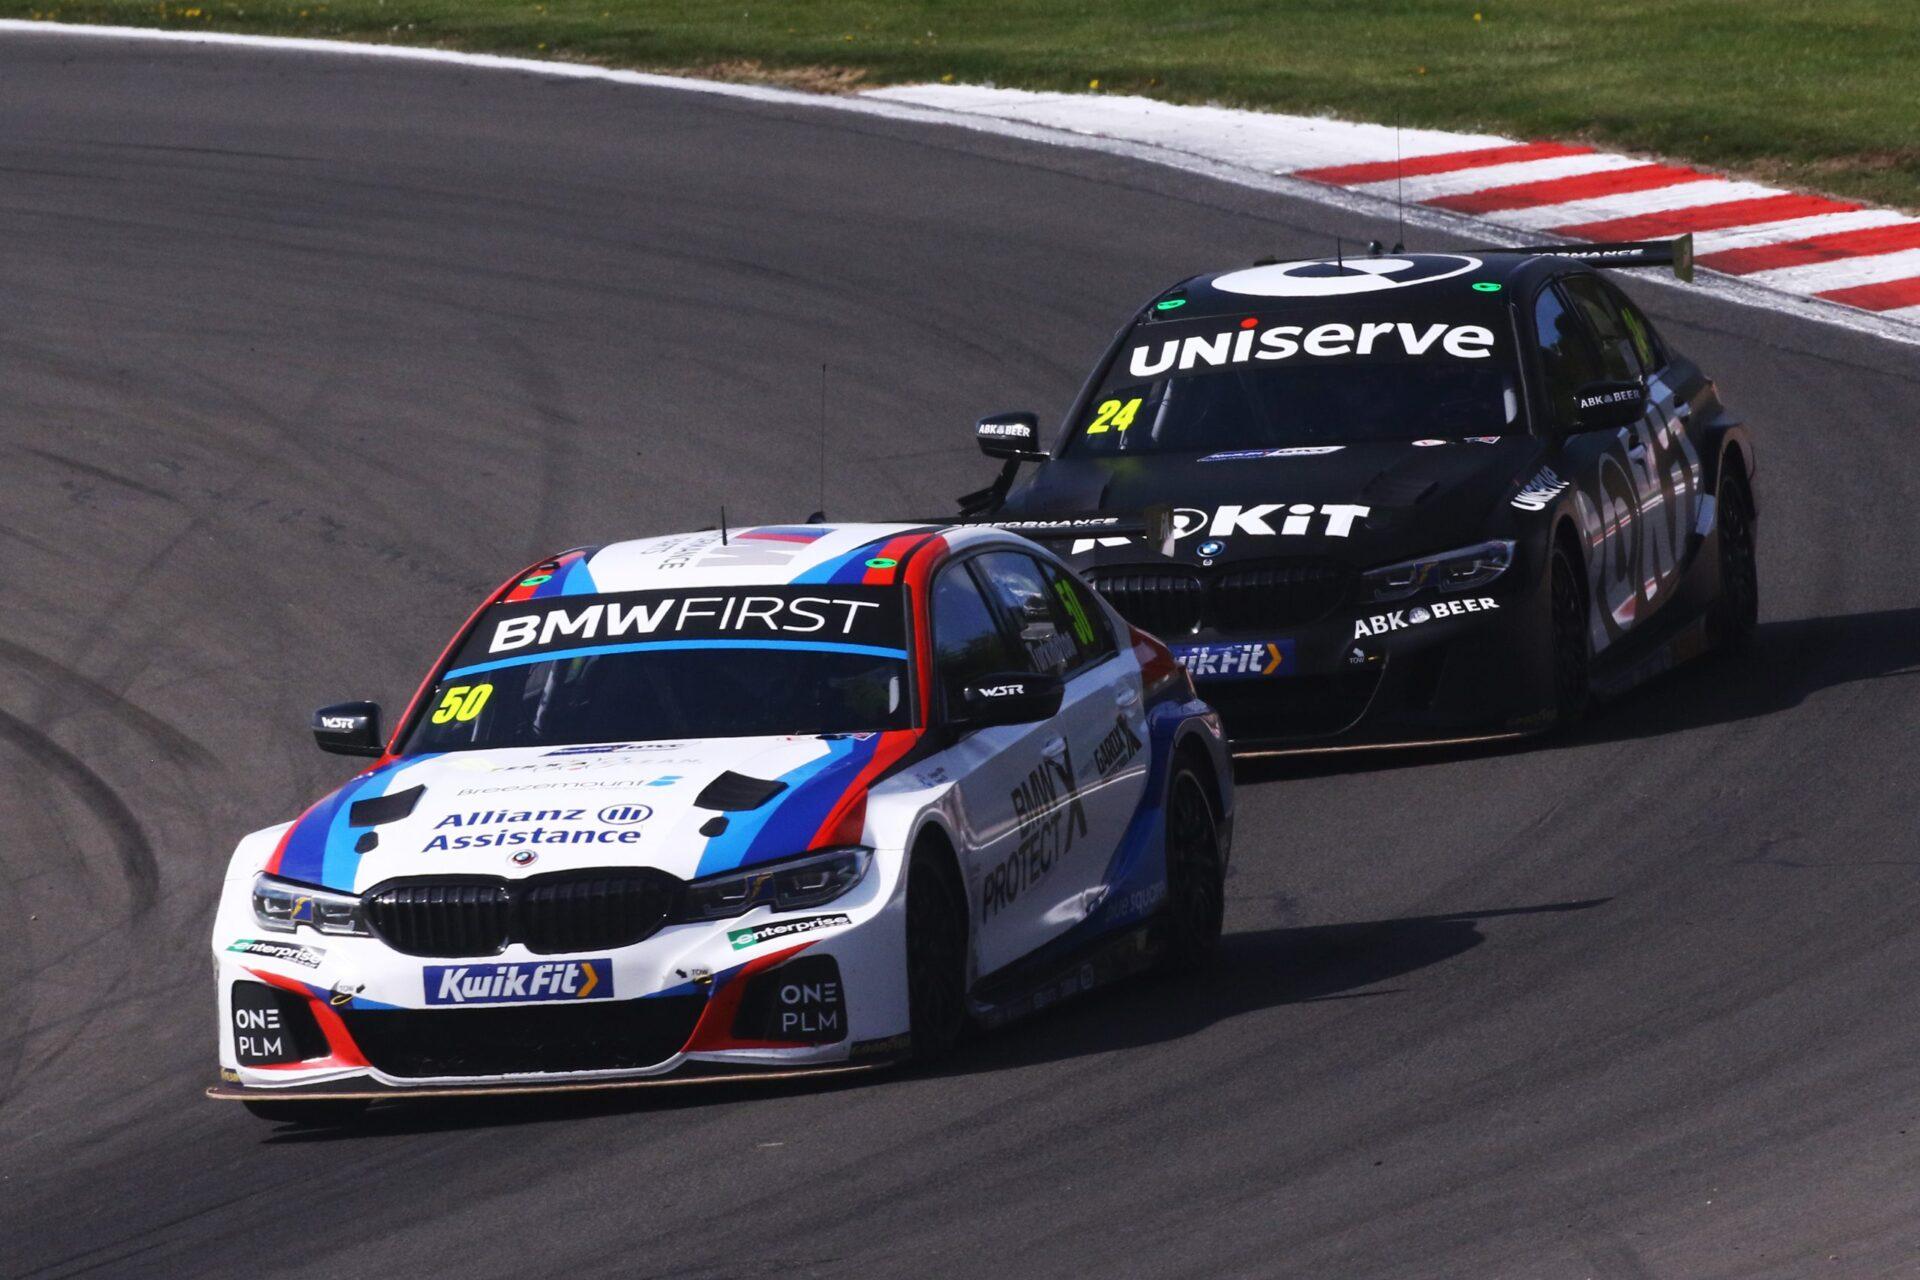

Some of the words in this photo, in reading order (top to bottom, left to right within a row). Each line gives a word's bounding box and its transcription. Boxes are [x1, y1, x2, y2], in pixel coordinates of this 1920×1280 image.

[1580, 395, 1604, 409] ABK
[1613, 388, 1641, 402] BEER
[1086, 398, 1143, 435] 24
[978, 423, 998, 435] ABK
[1004, 424, 1031, 438] BEER
[1353, 609, 1409, 640] ABK
[1429, 596, 1500, 619] BEER
[1174, 643, 1266, 675] ikFit
[1350, 656, 1365, 664] TOW
[978, 684, 1025, 698] WSR
[432, 682, 495, 725] 50
[321, 716, 355, 729] WSR
[457, 777, 647, 797] Breezemount
[433, 808, 587, 829] Allianz
[424, 827, 642, 852] Assistance
[983, 808, 1062, 925] PROTECT
[729, 916, 849, 946] enterprise
[229, 941, 323, 965] enterprise
[691, 968, 709, 976] TOW
[780, 982, 837, 1004] ONE
[236, 1009, 280, 1029] ONE
[782, 1011, 838, 1032] PLM
[238, 1036, 283, 1056] PLM
